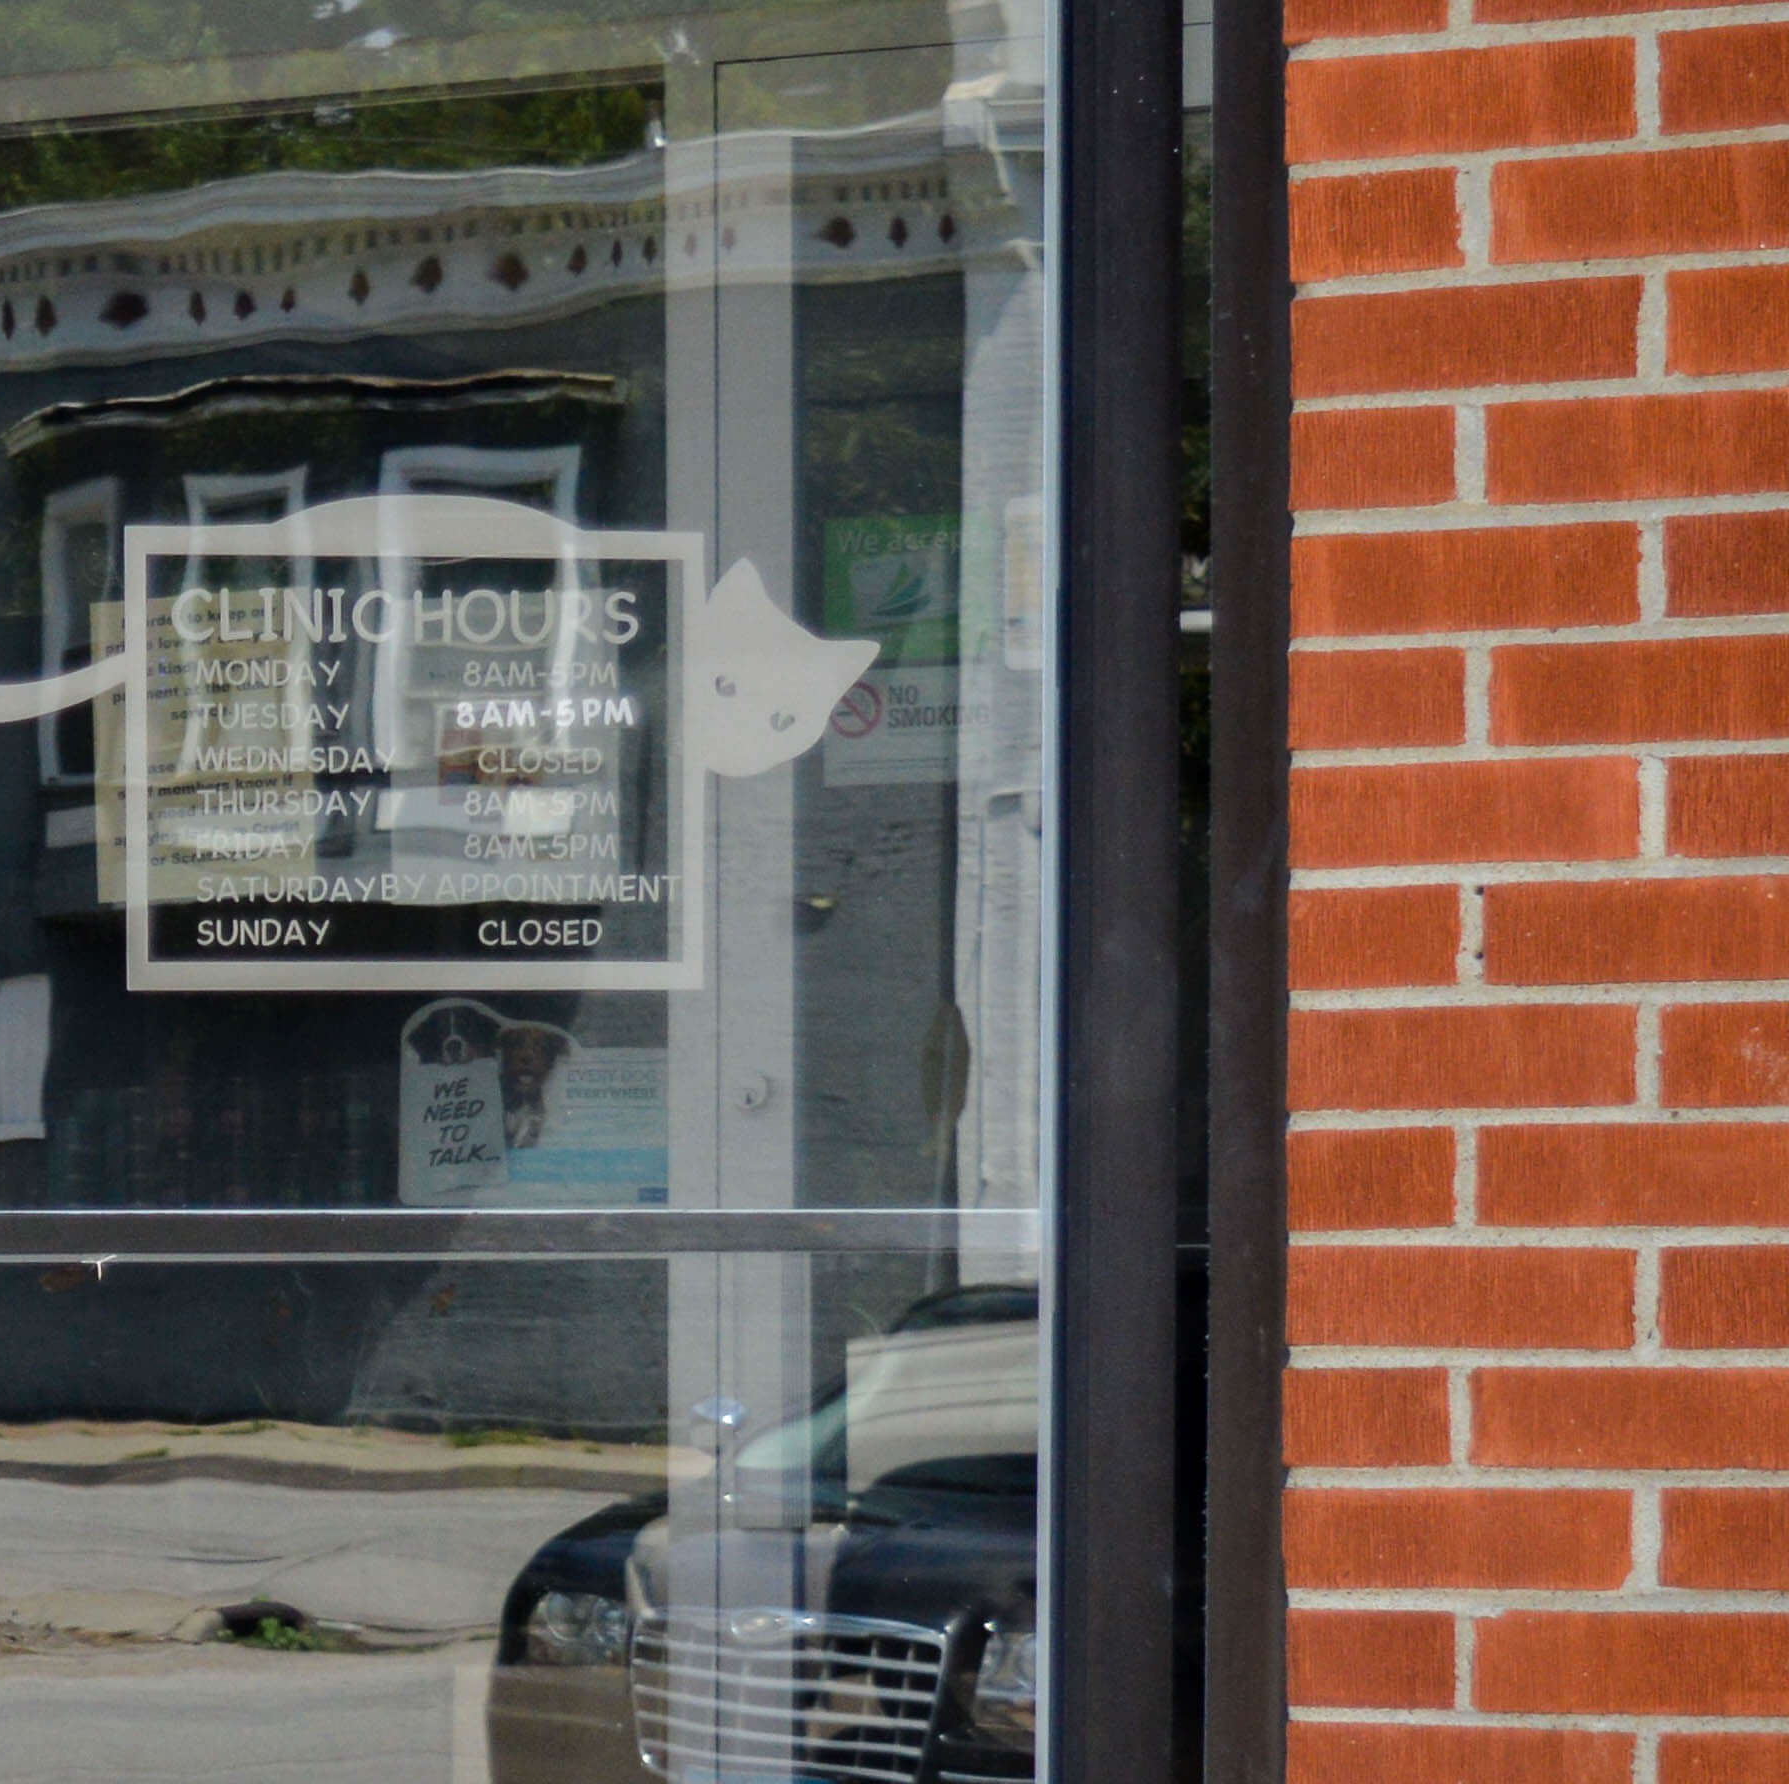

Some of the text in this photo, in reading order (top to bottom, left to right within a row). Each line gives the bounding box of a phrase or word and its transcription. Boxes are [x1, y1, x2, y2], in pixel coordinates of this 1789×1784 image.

[172, 588, 639, 645] CLINIC HOURS
[195, 659, 341, 688] MONDAY
[462, 660, 618, 689] 8AM-5PM
[888, 684, 919, 705] NO
[199, 697, 635, 731] TUESDAY 8AM-5PM
[196, 745, 396, 775] WEDNESDAY
[477, 747, 603, 775] CLOSED
[235, 776, 278, 789] know
[196, 788, 371, 818] THURSDAY
[462, 790, 619, 817] 8AM-5PM
[196, 833, 314, 860] FRIDAY
[462, 832, 619, 861] 8AM-5PM
[196, 873, 684, 904] SATURDAY BY APPOINTMENT
[197, 916, 604, 948] SUNDAY CLOSED
[434, 1077, 470, 1100] WE
[423, 1099, 486, 1124] NEED
[439, 1124, 471, 1143] TO
